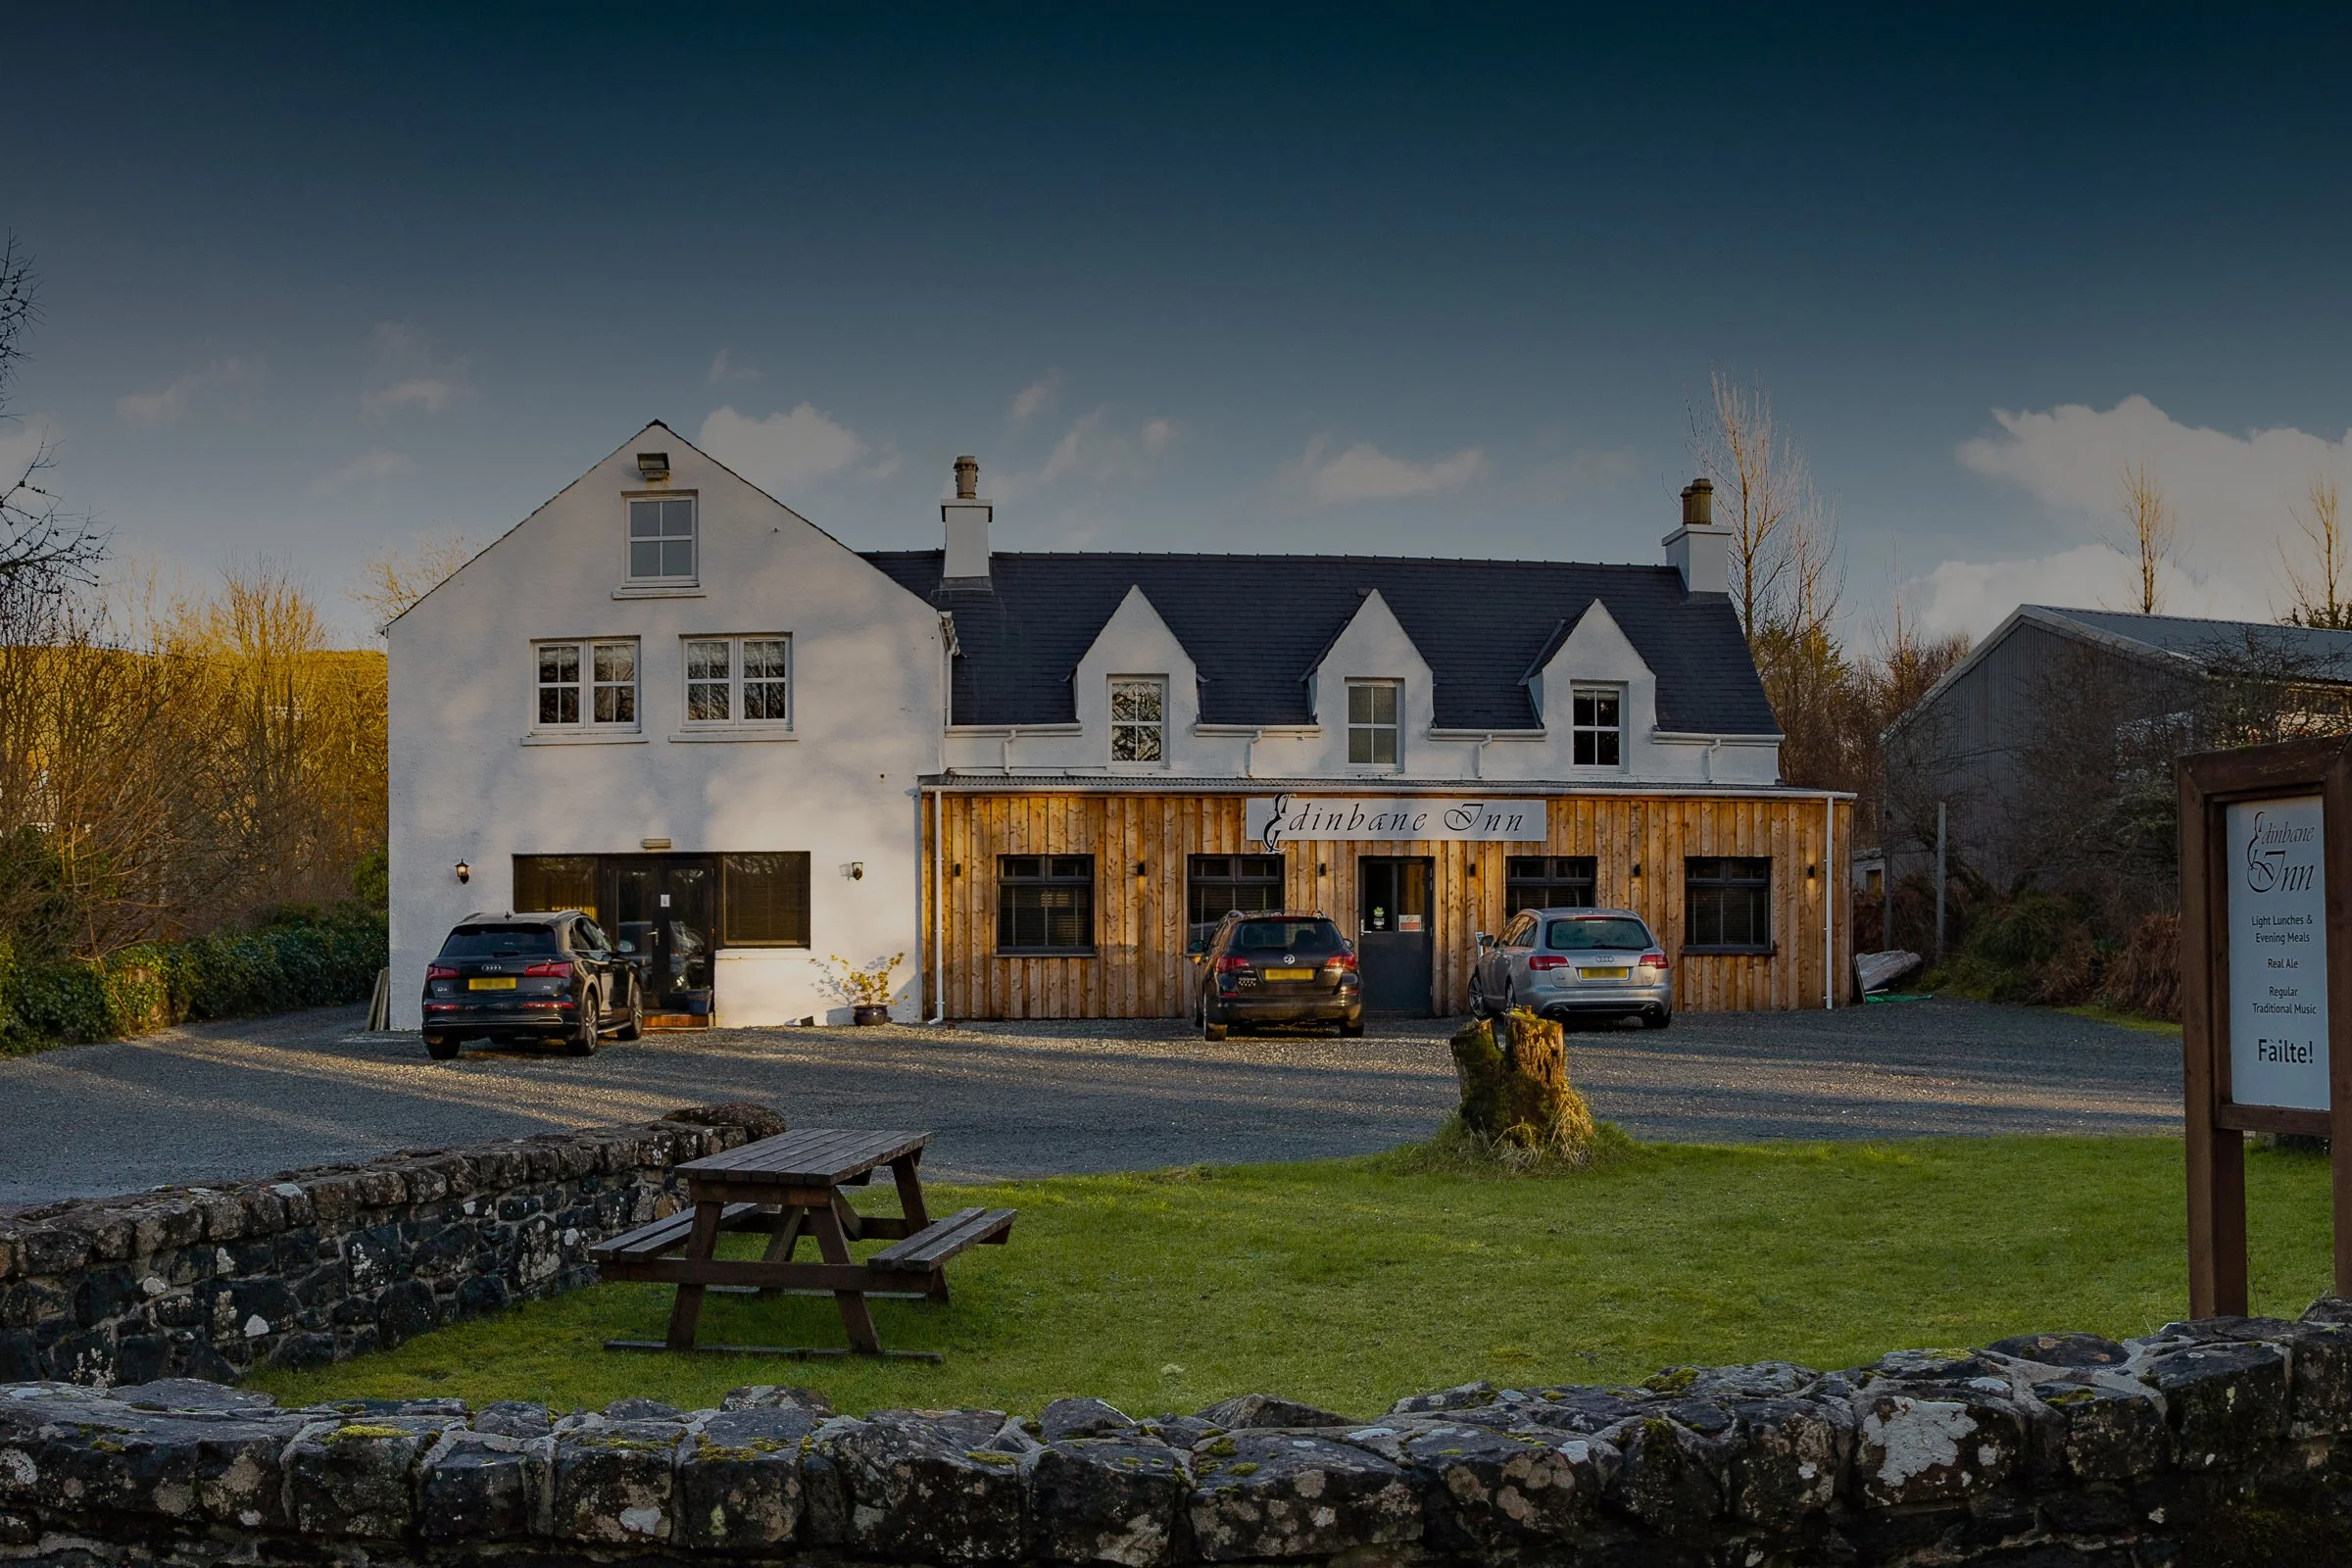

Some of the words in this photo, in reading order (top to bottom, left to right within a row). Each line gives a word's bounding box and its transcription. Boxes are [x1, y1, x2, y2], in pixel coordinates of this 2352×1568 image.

[1262, 793, 1427, 854] Edinbane
[1444, 803, 1524, 832] Inn
[2246, 810, 2315, 870] Edinbane
[2246, 851, 2315, 893] Inn
[2251, 915, 2271, 928] Light
[2273, 914, 2304, 925] Lunches
[2306, 913, 2314, 925] &
[2255, 932, 2285, 945] Evening
[2287, 932, 2310, 943] Meals
[2268, 957, 2284, 968] Real
[2285, 958, 2298, 968] Ale
[2269, 986, 2298, 999] Regular
[2252, 1003, 2292, 1014] Traditional
[2294, 1004, 2317, 1014] Music
[2258, 1039, 2314, 1064] Fàilte!
